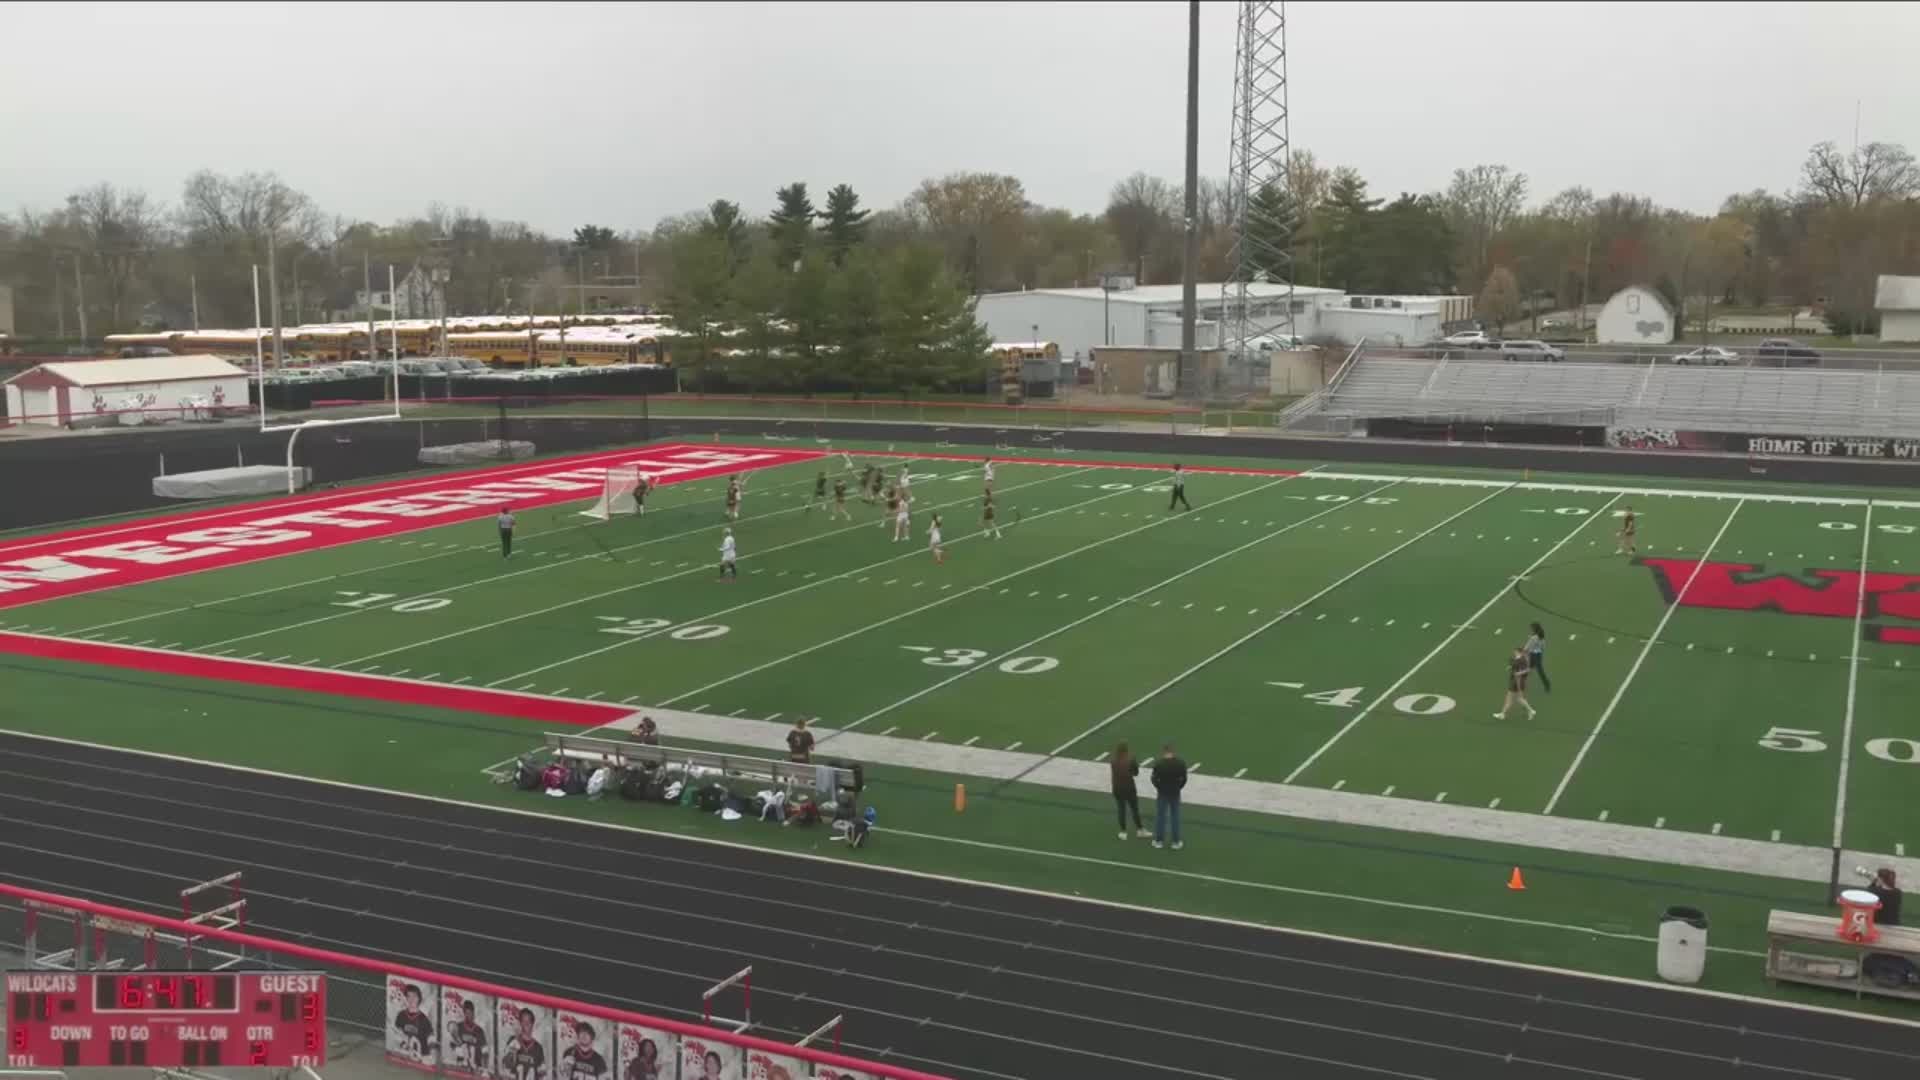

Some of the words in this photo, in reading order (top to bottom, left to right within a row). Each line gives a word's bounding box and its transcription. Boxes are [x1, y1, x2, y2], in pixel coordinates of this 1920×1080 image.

[1748, 437, 1805, 454] HOME
[1811, 441, 1838, 455] OF
[1845, 443, 1885, 457] THE
